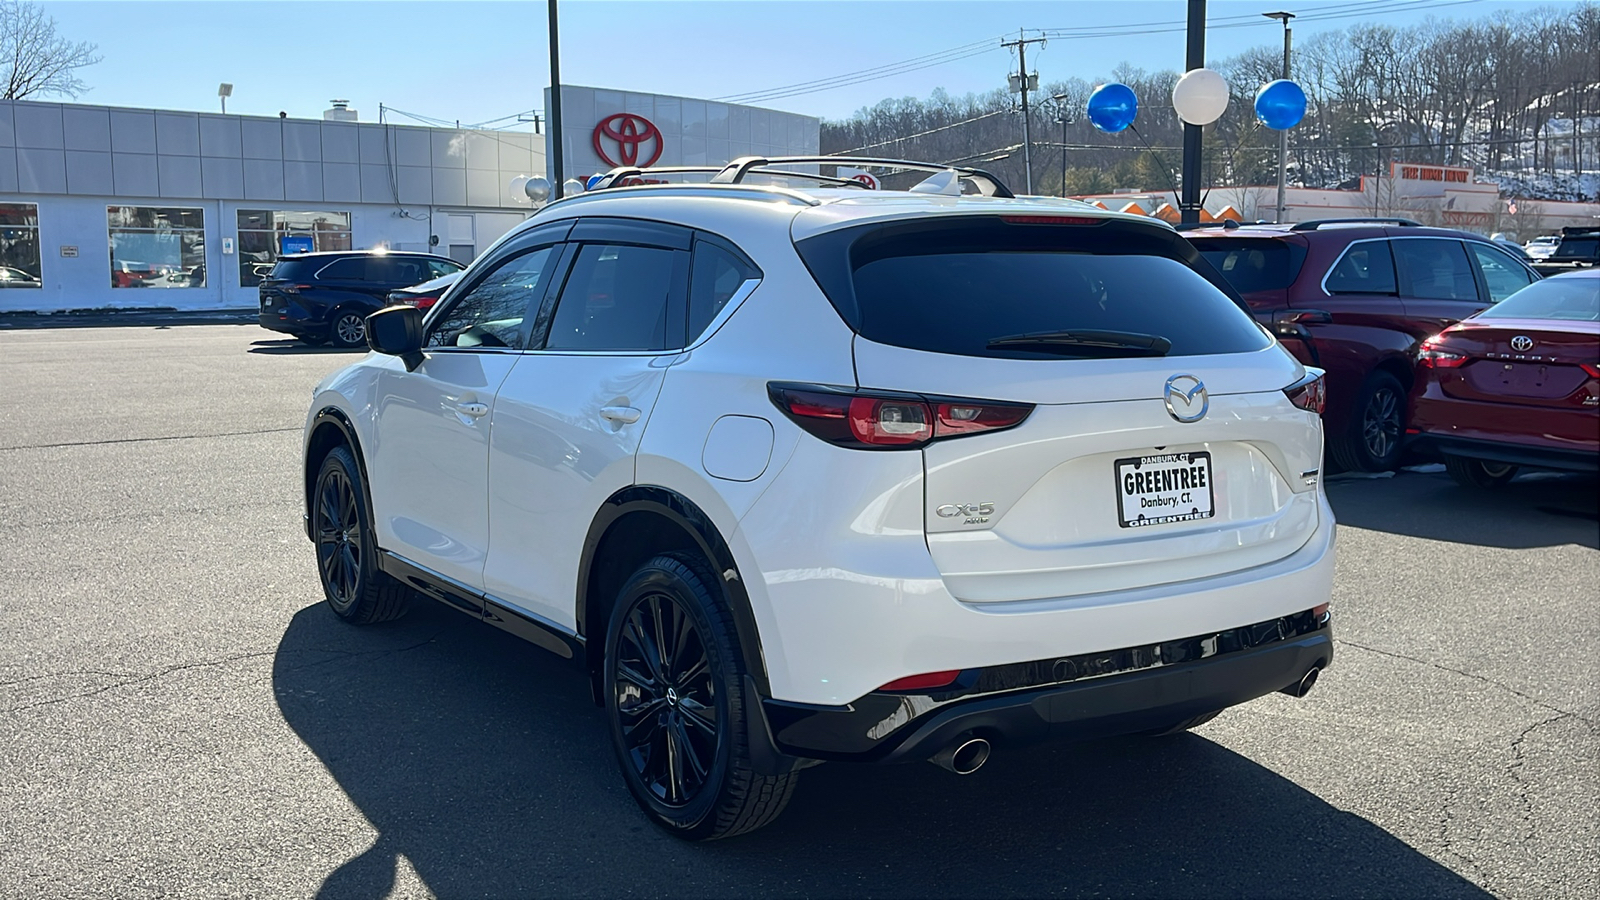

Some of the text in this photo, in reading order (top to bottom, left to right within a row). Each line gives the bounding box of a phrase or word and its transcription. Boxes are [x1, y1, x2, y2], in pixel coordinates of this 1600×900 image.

[1420, 168, 1443, 181] HOME
[1444, 170, 1469, 183] DEPOT
[1140, 453, 1190, 465] DANBURY, CT
[1124, 466, 1206, 495] GREENTREE
[1140, 492, 1193, 508] Danbury, CT.
[935, 501, 995, 518] CX-5
[963, 517, 990, 525] AWD
[1128, 512, 1211, 527] GREENTREE
